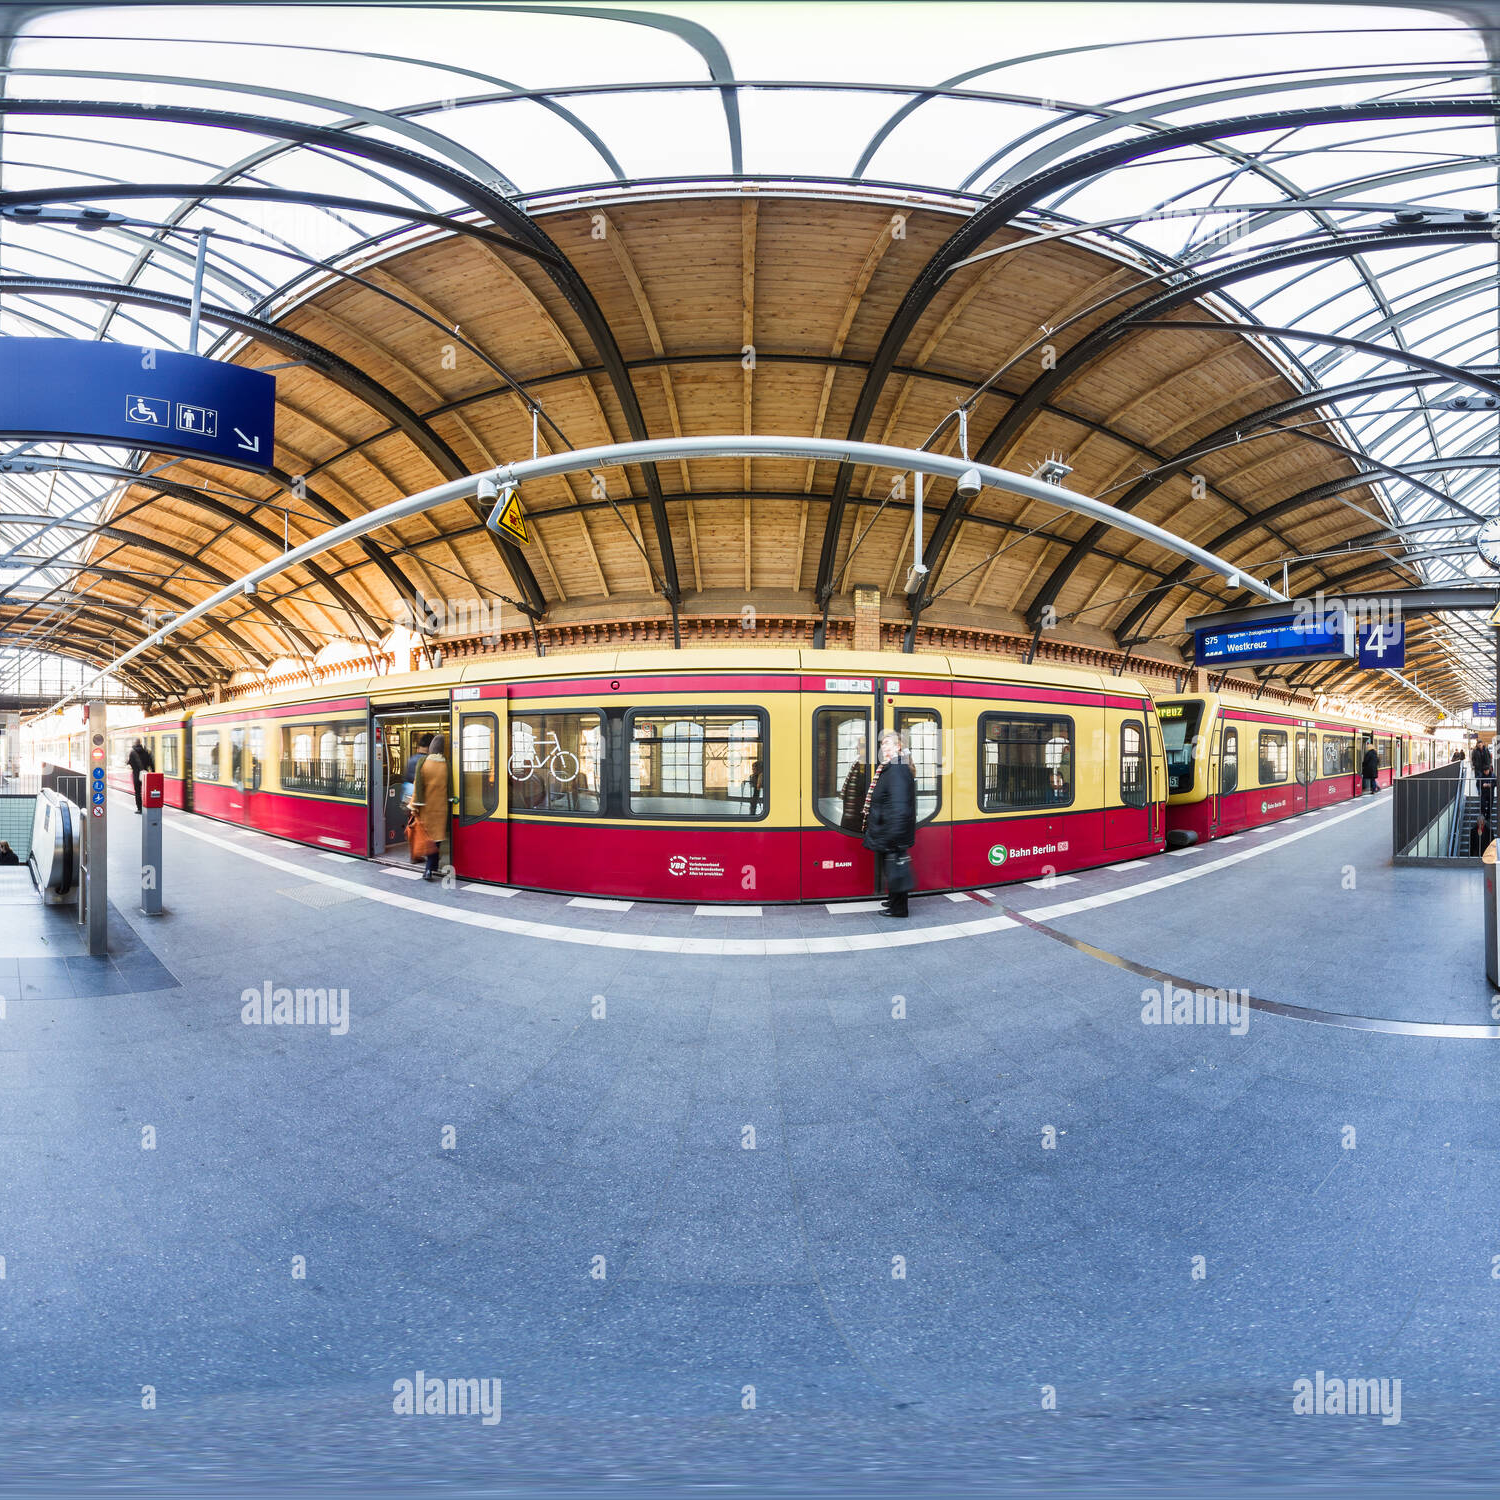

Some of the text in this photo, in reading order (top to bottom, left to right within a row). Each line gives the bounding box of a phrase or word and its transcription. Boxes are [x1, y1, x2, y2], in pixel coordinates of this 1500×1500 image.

[1205, 636, 1218, 645] S75
[1227, 641, 1267, 652] Westkreuz
[1365, 624, 1387, 657] 4
[1010, 848, 1030, 858] Bahn
[1033, 844, 1056, 855] Berlin
